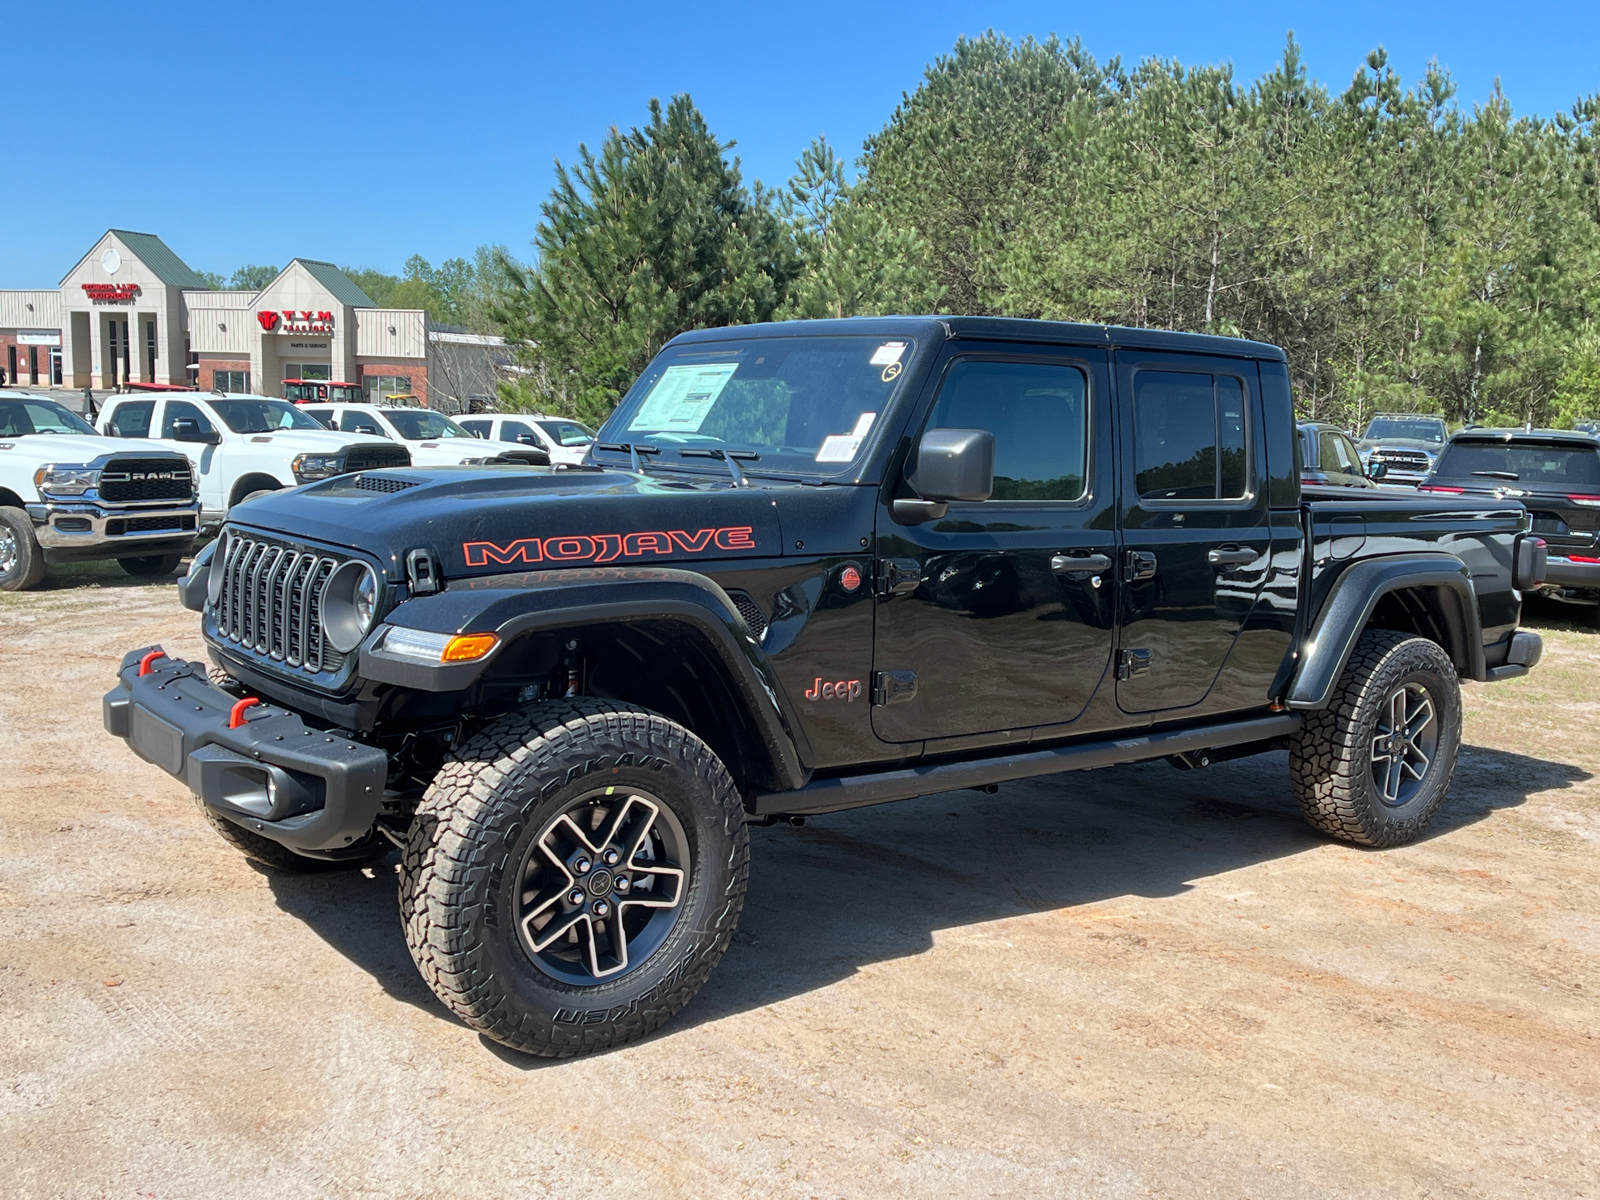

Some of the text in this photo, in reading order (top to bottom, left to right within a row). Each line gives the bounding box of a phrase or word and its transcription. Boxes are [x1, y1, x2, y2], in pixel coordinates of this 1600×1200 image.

[87, 292, 132, 300] EQUIPMENT
[281, 310, 331, 321] TYM
[282, 324, 332, 332] TRACTORS
[132, 472, 171, 480] RAM
[463, 526, 755, 566] MOJAVE
[804, 677, 862, 702] Jeep
[552, 944, 698, 1026] FALKEN
